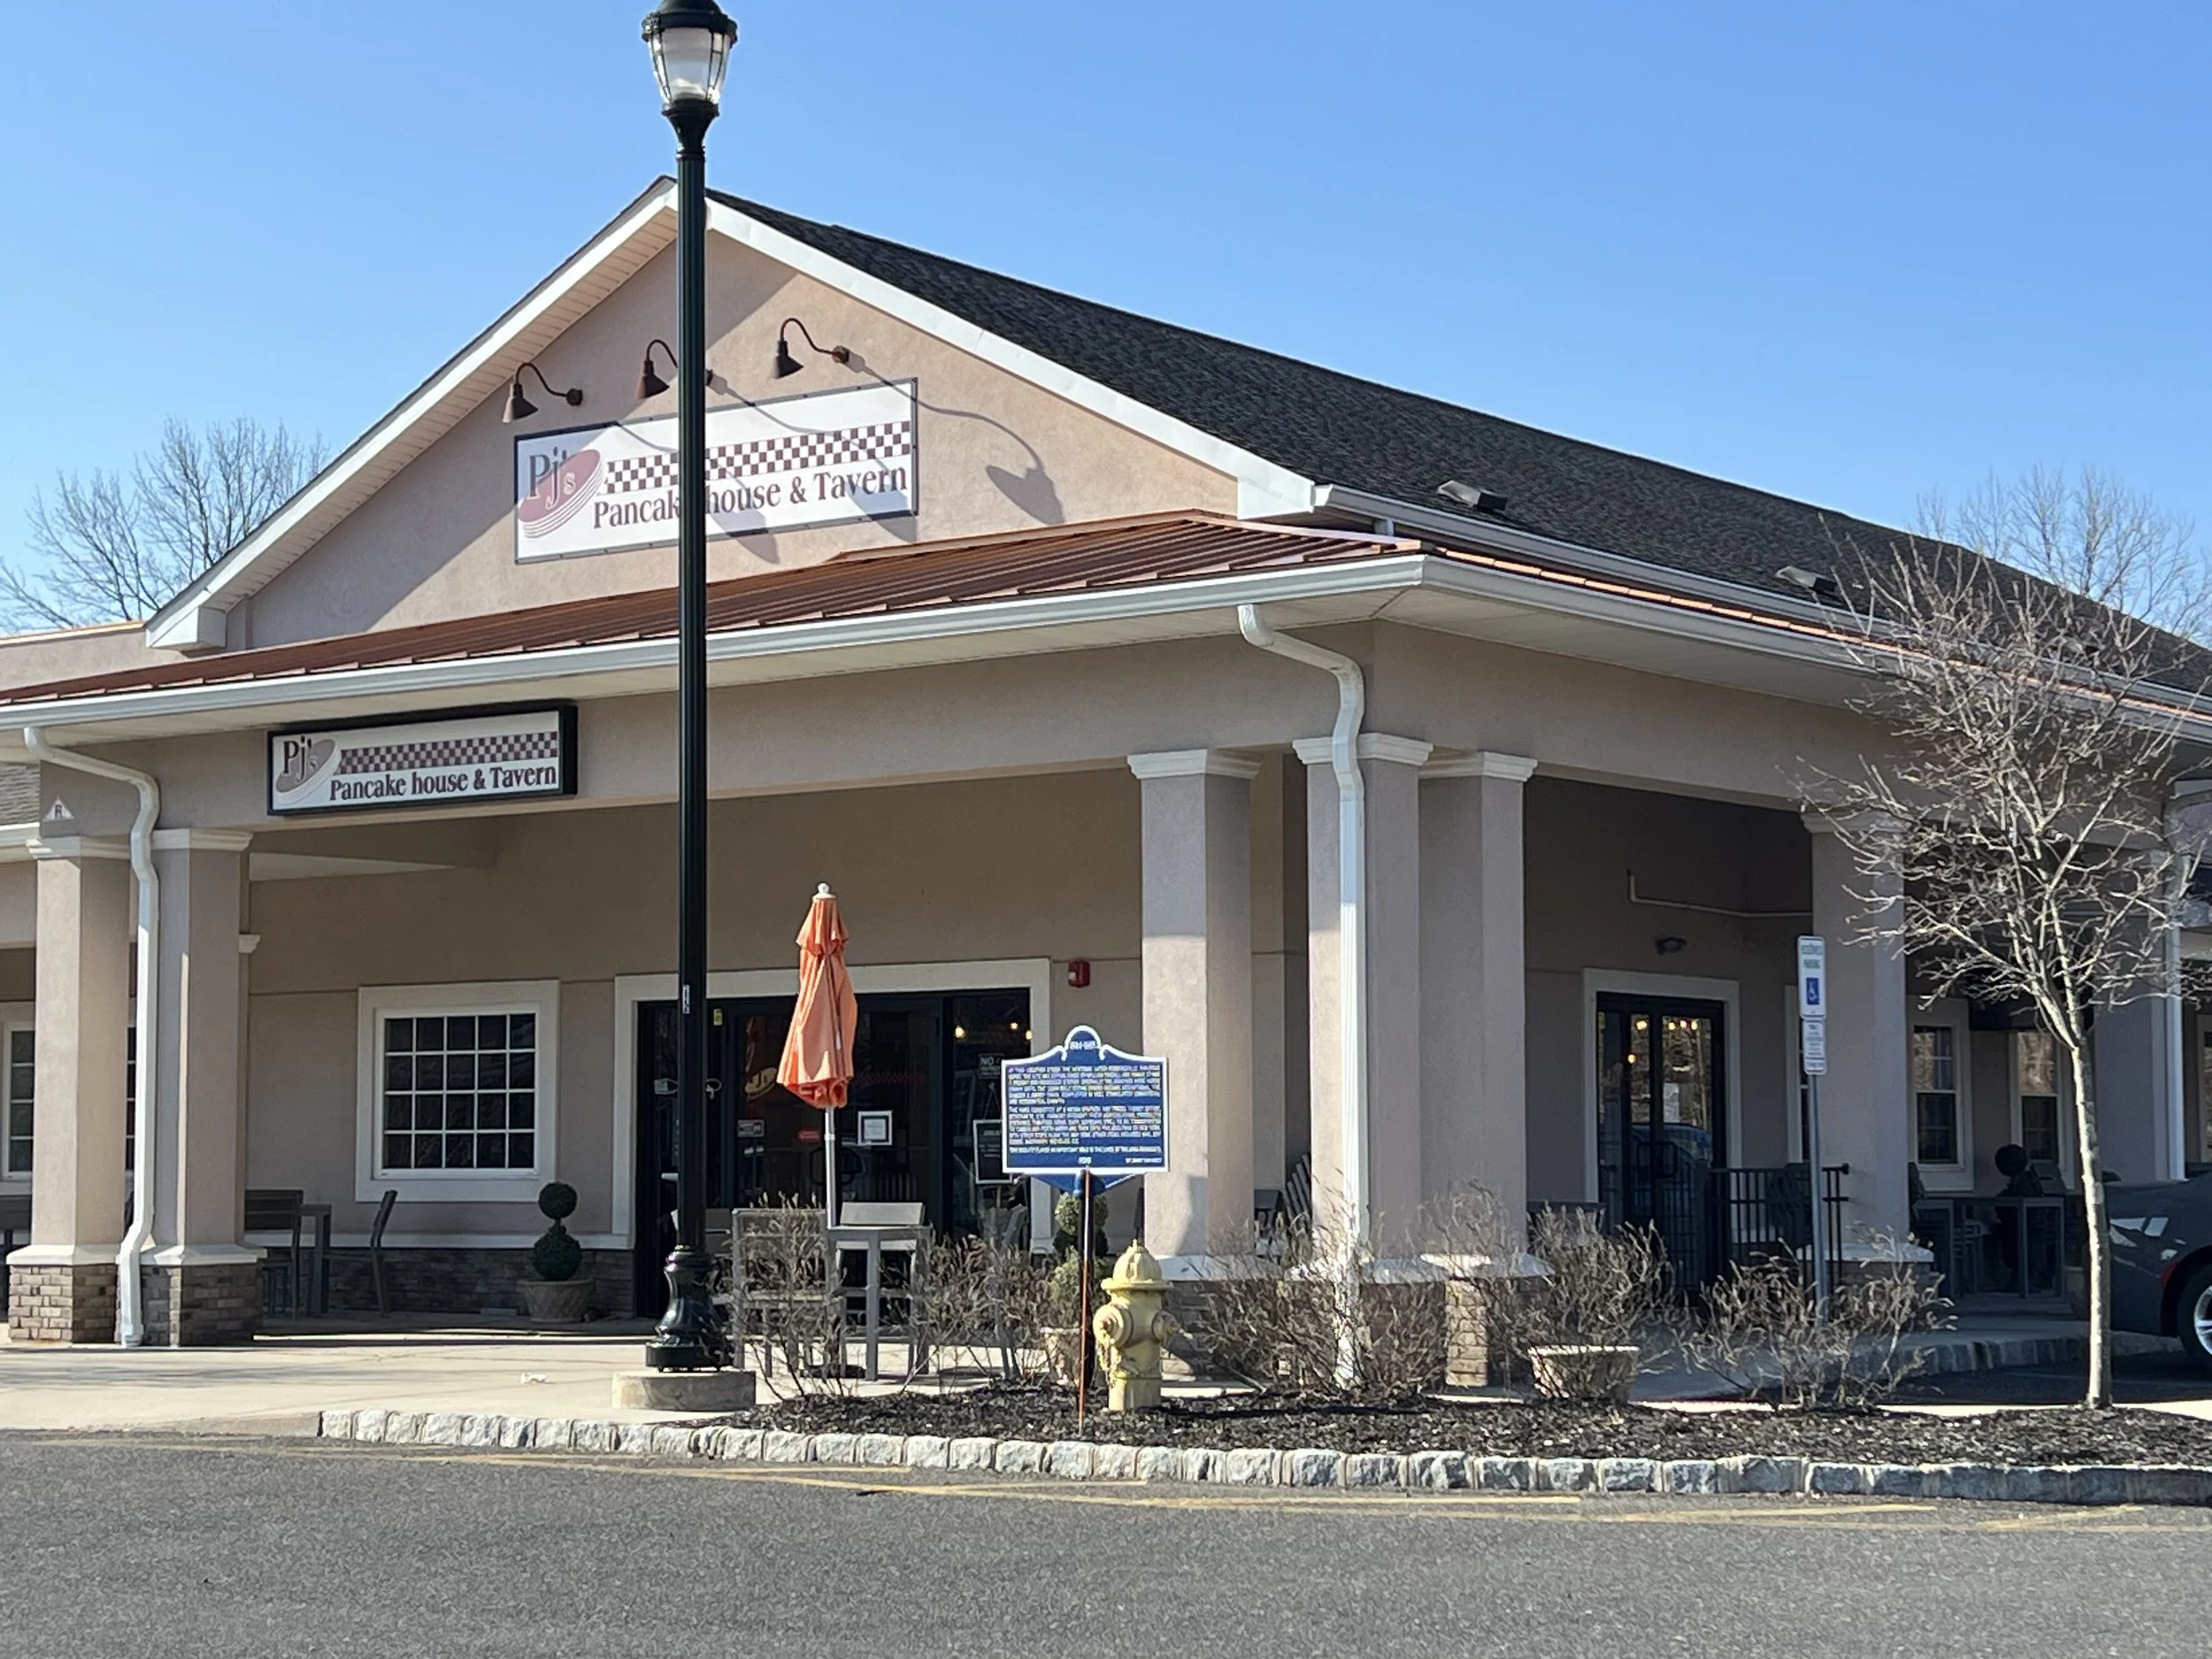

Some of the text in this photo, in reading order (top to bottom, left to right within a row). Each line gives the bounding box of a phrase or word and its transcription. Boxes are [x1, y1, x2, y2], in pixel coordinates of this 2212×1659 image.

[527, 446, 575, 509] Pj's
[593, 467, 907, 529] Pancak house & Tavern
[330, 766, 557, 800] Pancake house & Tavern
